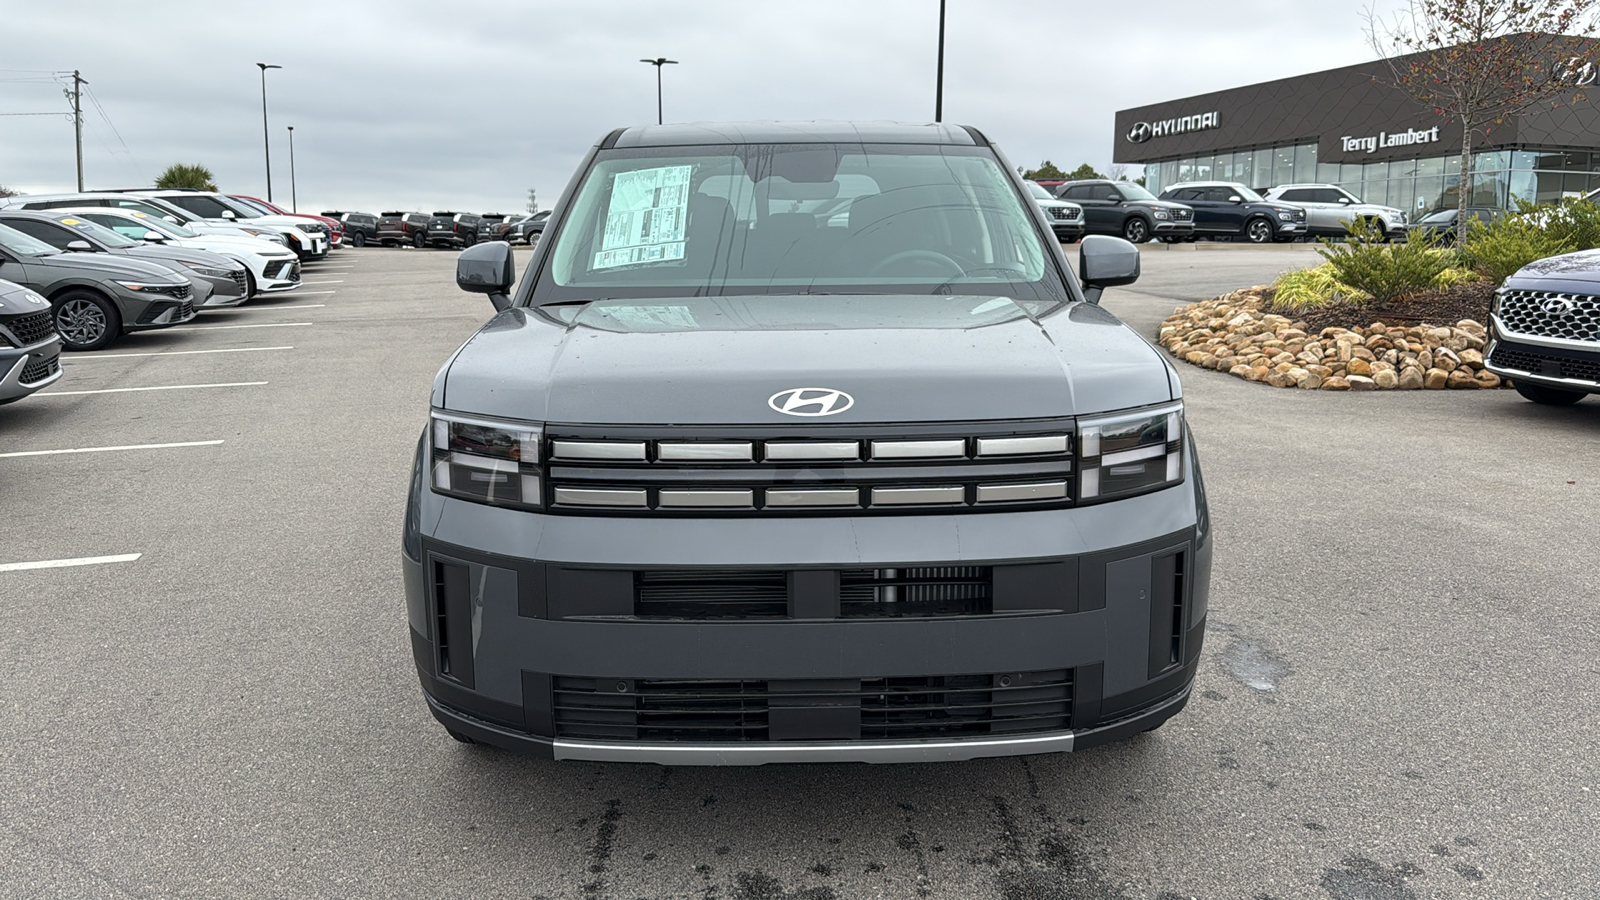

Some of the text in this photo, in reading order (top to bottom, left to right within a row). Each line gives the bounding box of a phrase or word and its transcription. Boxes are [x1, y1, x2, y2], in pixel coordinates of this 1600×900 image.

[1152, 111, 1219, 137] HYUNDAI
[1341, 126, 1440, 154] Terry Lambert
